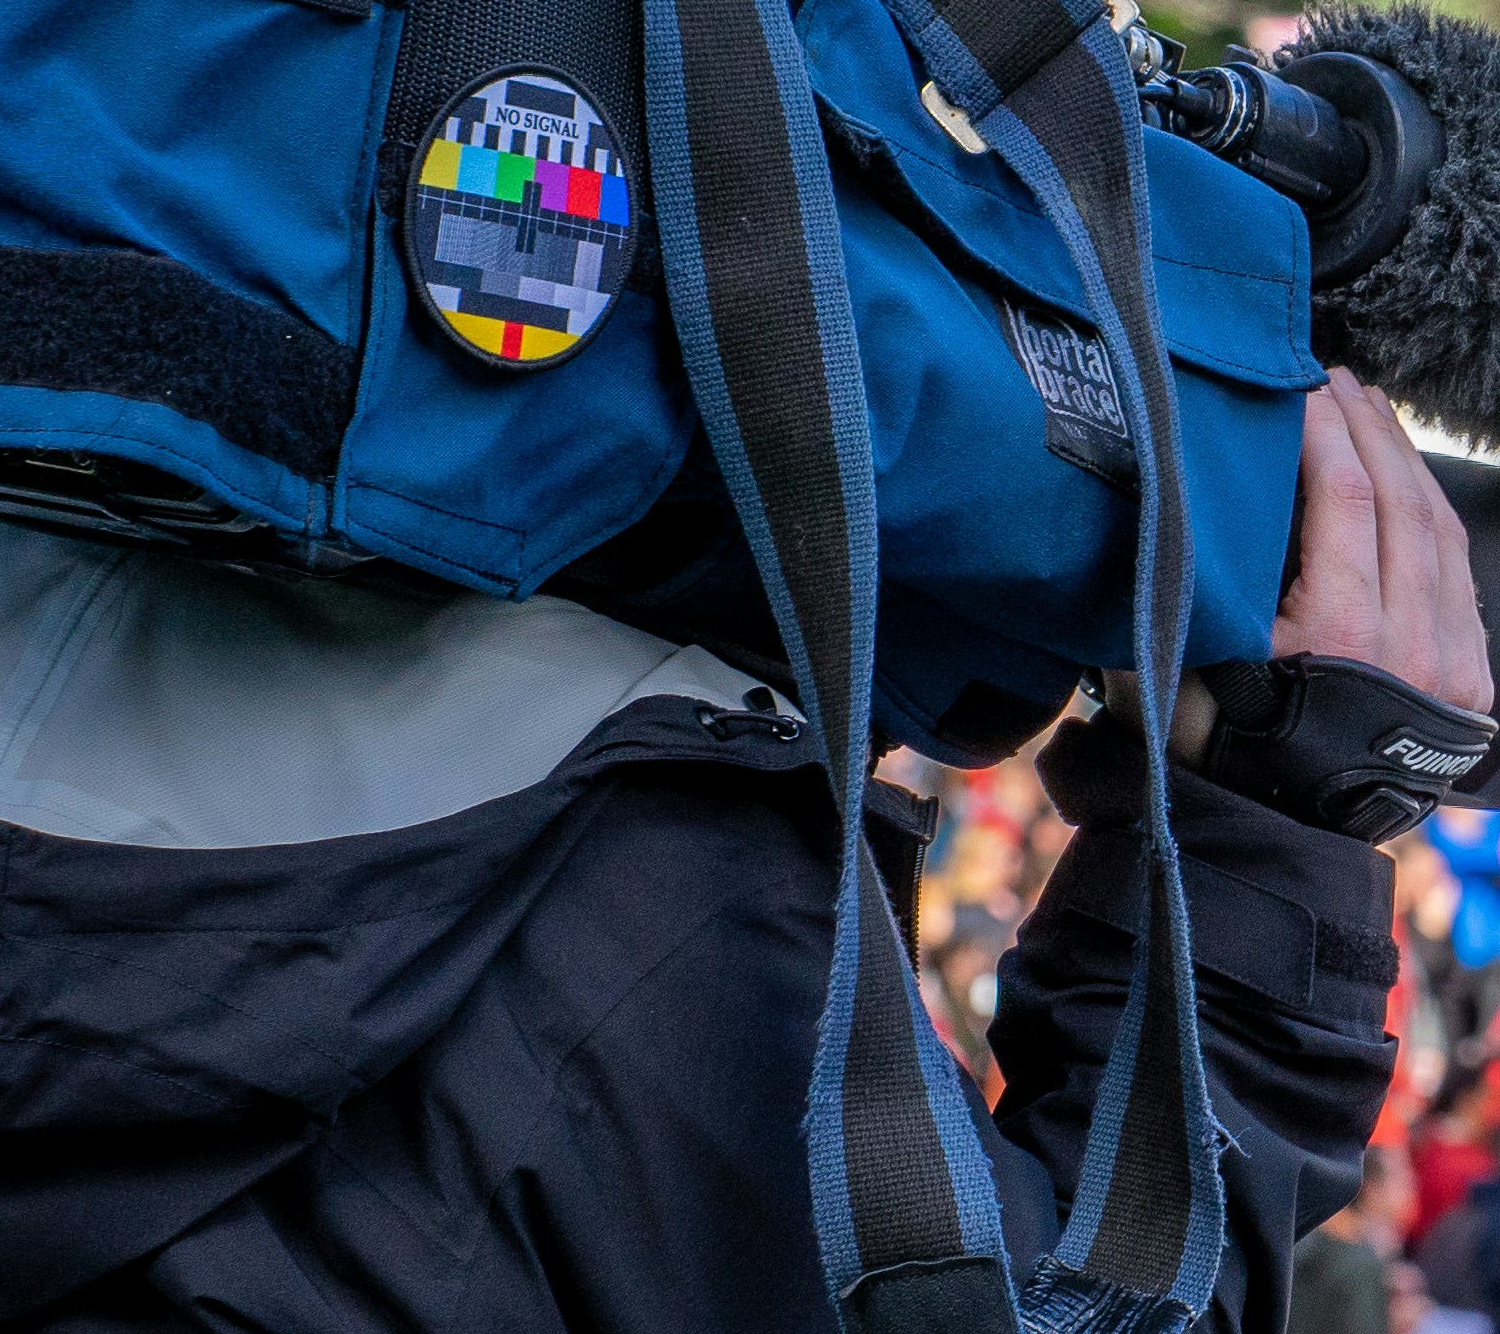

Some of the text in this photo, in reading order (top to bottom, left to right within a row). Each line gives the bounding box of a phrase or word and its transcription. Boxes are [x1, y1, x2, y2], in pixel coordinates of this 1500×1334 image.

[495, 107, 580, 139] NO SIGNAL
[1019, 310, 1111, 386] porta
[1033, 361, 1121, 427] brace
